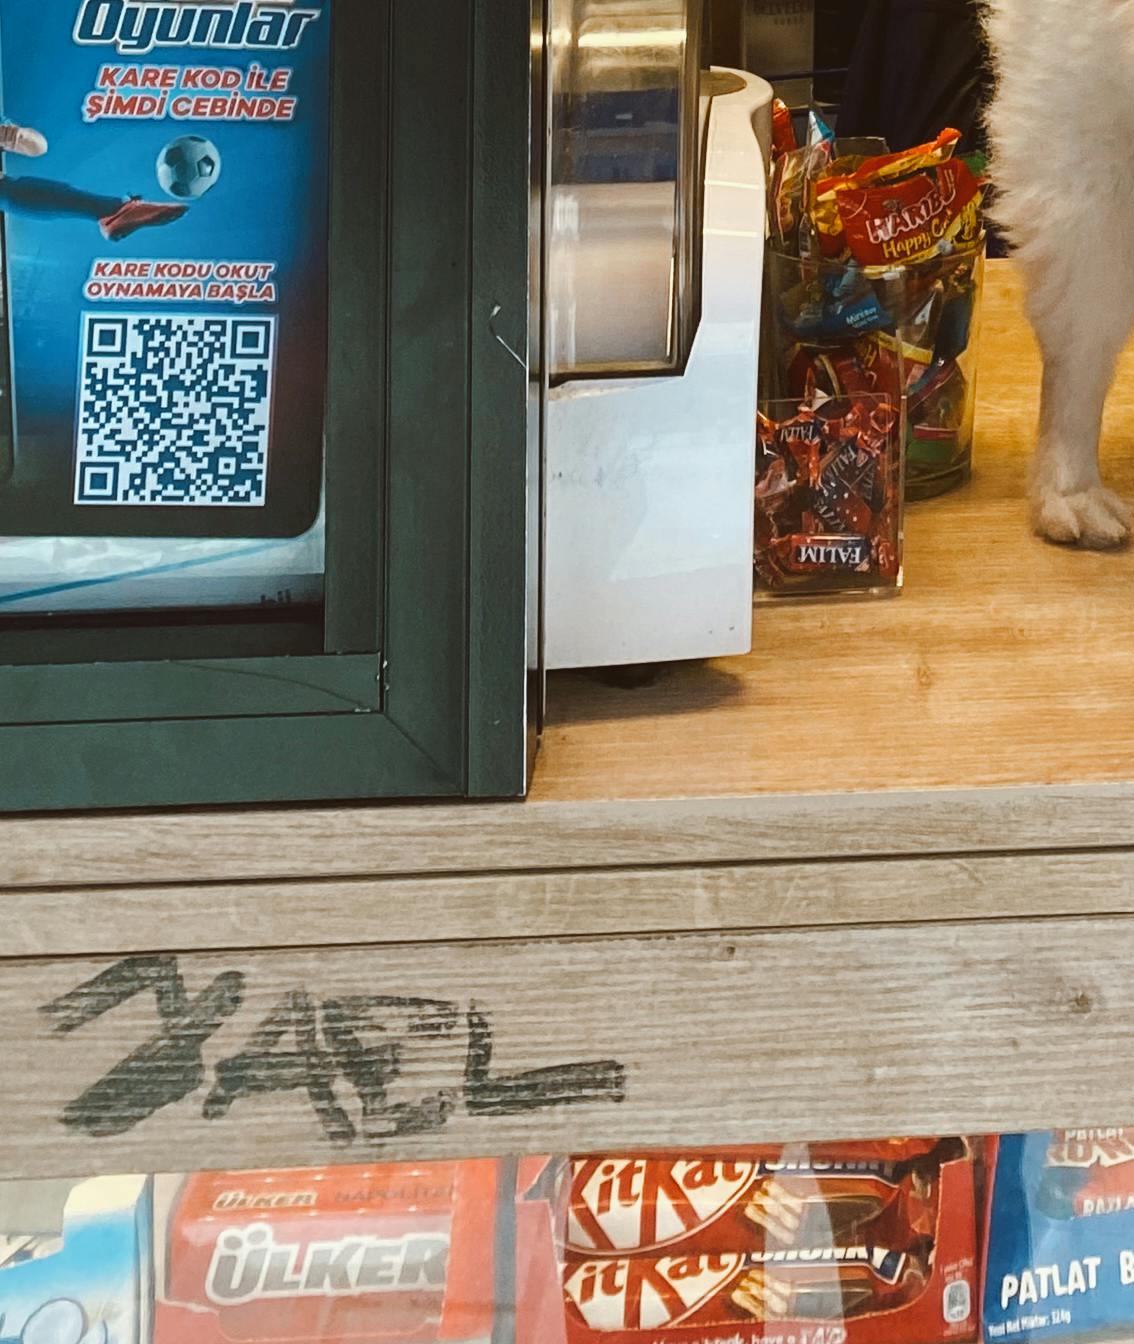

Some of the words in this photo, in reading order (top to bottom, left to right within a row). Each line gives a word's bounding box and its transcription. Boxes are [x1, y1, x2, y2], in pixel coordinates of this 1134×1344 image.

[99, 66, 180, 90] KARE
[182, 67, 242, 90] KOD
[247, 63, 290, 91] İLE
[86, 88, 167, 119] ŞİMDİ
[171, 89, 296, 120] CEBİNDE
[94, 262, 152, 278] KARE
[154, 263, 211, 279] KODU
[215, 264, 274, 280] OKUT
[86, 282, 202, 299] OYNAMAYA
[205, 284, 276, 302] BAŞLA
[799, 546, 862, 564] FALIM
[570, 1159, 746, 1250] KitKat
[207, 1225, 449, 1304] ÜLKER
[1001, 1256, 1102, 1310] PATLAT
